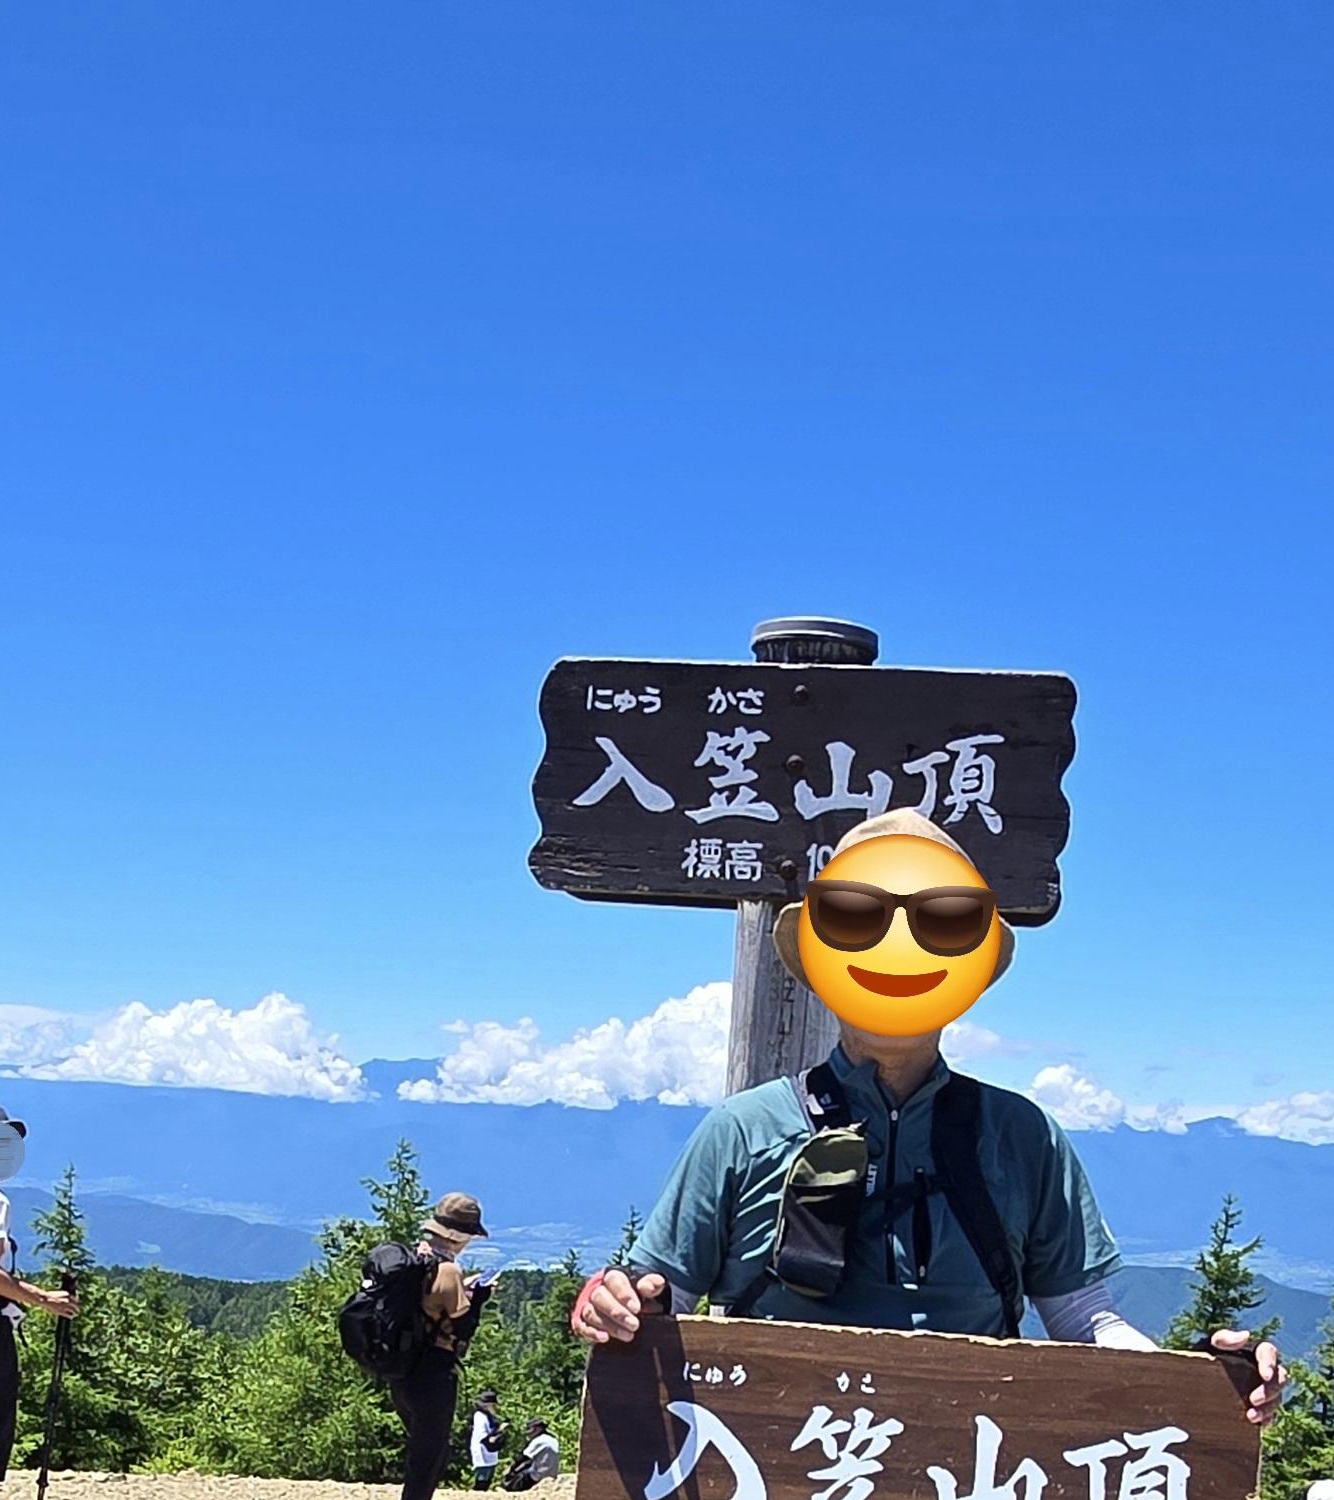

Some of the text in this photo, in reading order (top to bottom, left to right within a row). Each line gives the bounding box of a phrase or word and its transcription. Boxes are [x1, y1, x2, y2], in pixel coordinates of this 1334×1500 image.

[586, 685, 764, 715] にゅう かさ
[572, 726, 1005, 835] 入笠山頂
[681, 838, 764, 882] 標高
